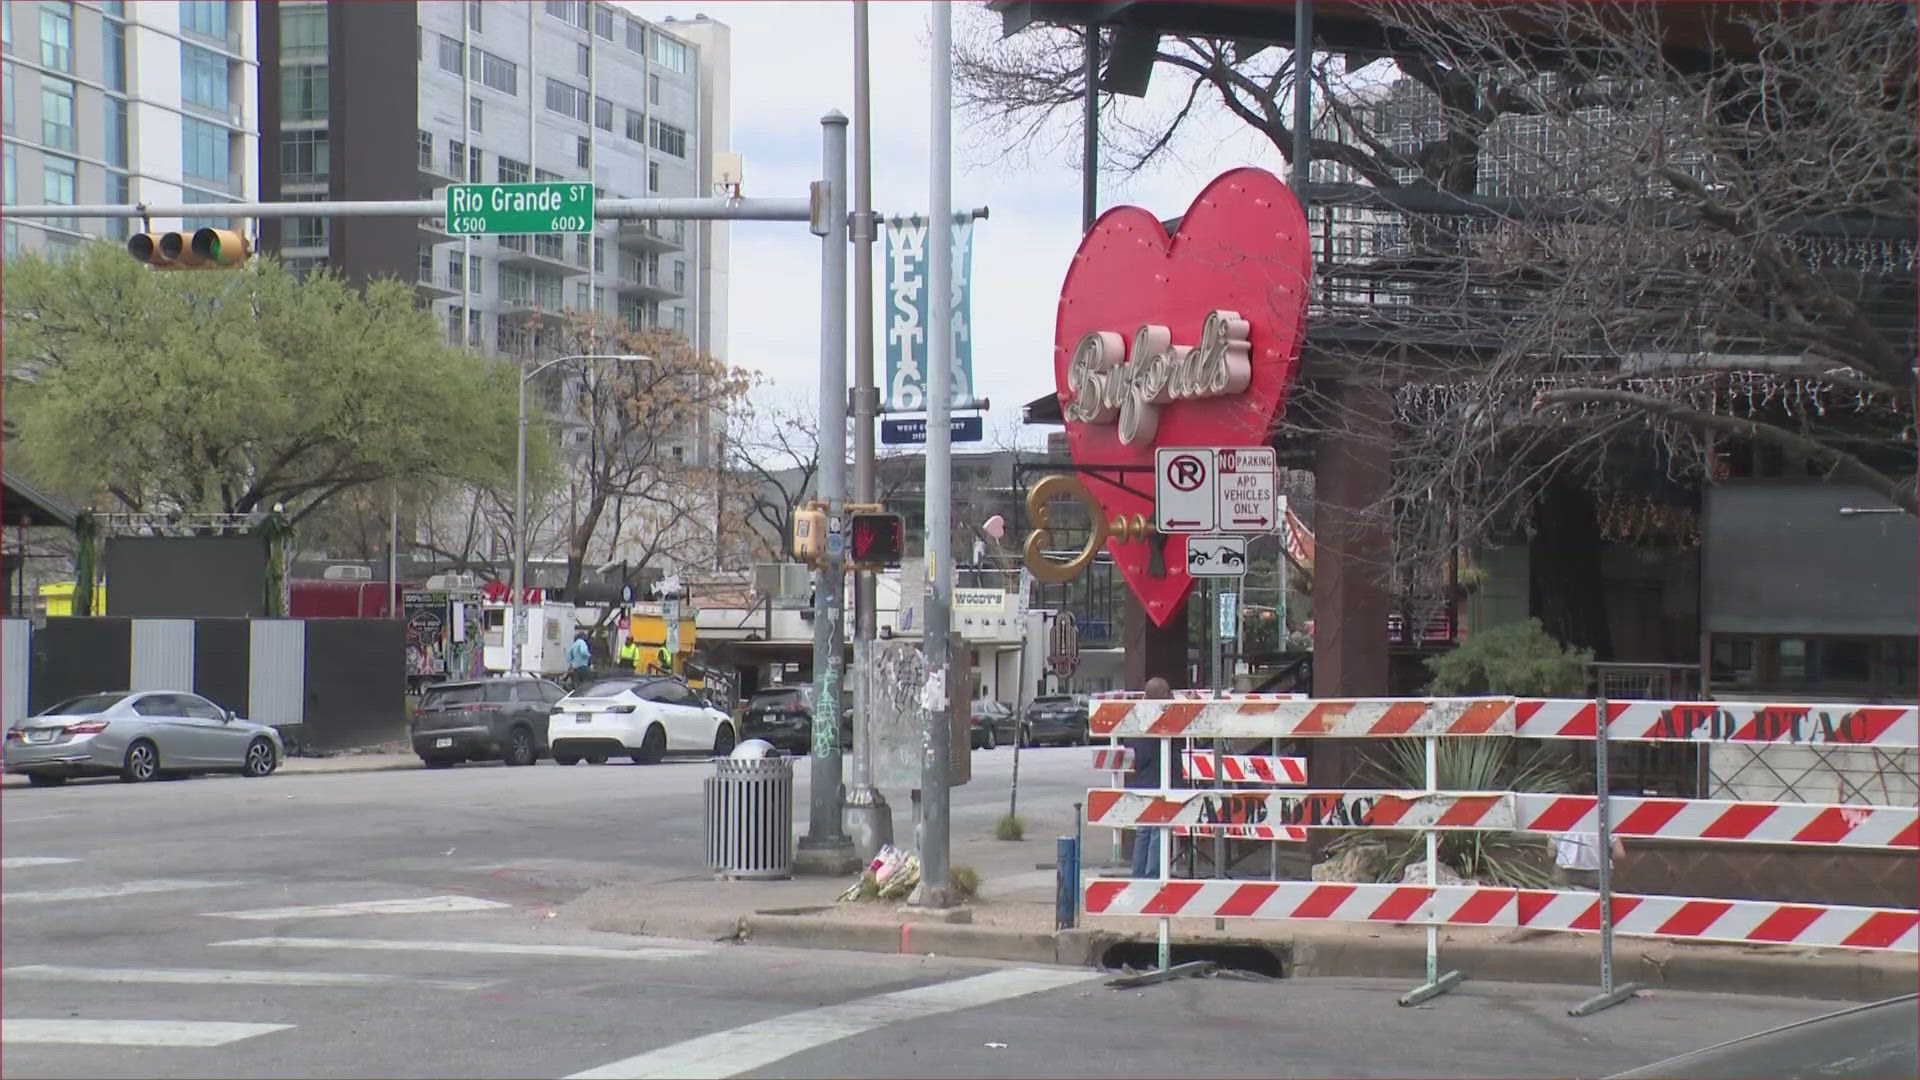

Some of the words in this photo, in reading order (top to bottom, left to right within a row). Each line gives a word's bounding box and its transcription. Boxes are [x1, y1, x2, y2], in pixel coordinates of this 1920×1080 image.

[453, 187, 483, 212] Rio
[491, 187, 562, 212] Grande
[569, 185, 586, 202] ST
[462, 217, 486, 232] 500
[551, 216, 576, 231] 600
[888, 215, 928, 368] WEST
[892, 368, 924, 410] 6
[896, 424, 918, 432] WEST
[1220, 453, 1236, 470] NO
[1237, 456, 1272, 467] PARKING
[1237, 475, 1257, 487] APD
[1224, 489, 1270, 501] VEHICLES
[1233, 503, 1259, 514] ONLY
[1652, 708, 1737, 741] APD
[1753, 710, 1868, 745] DTAC
[1197, 796, 1268, 825] APD
[1281, 796, 1374, 826] DTAC
